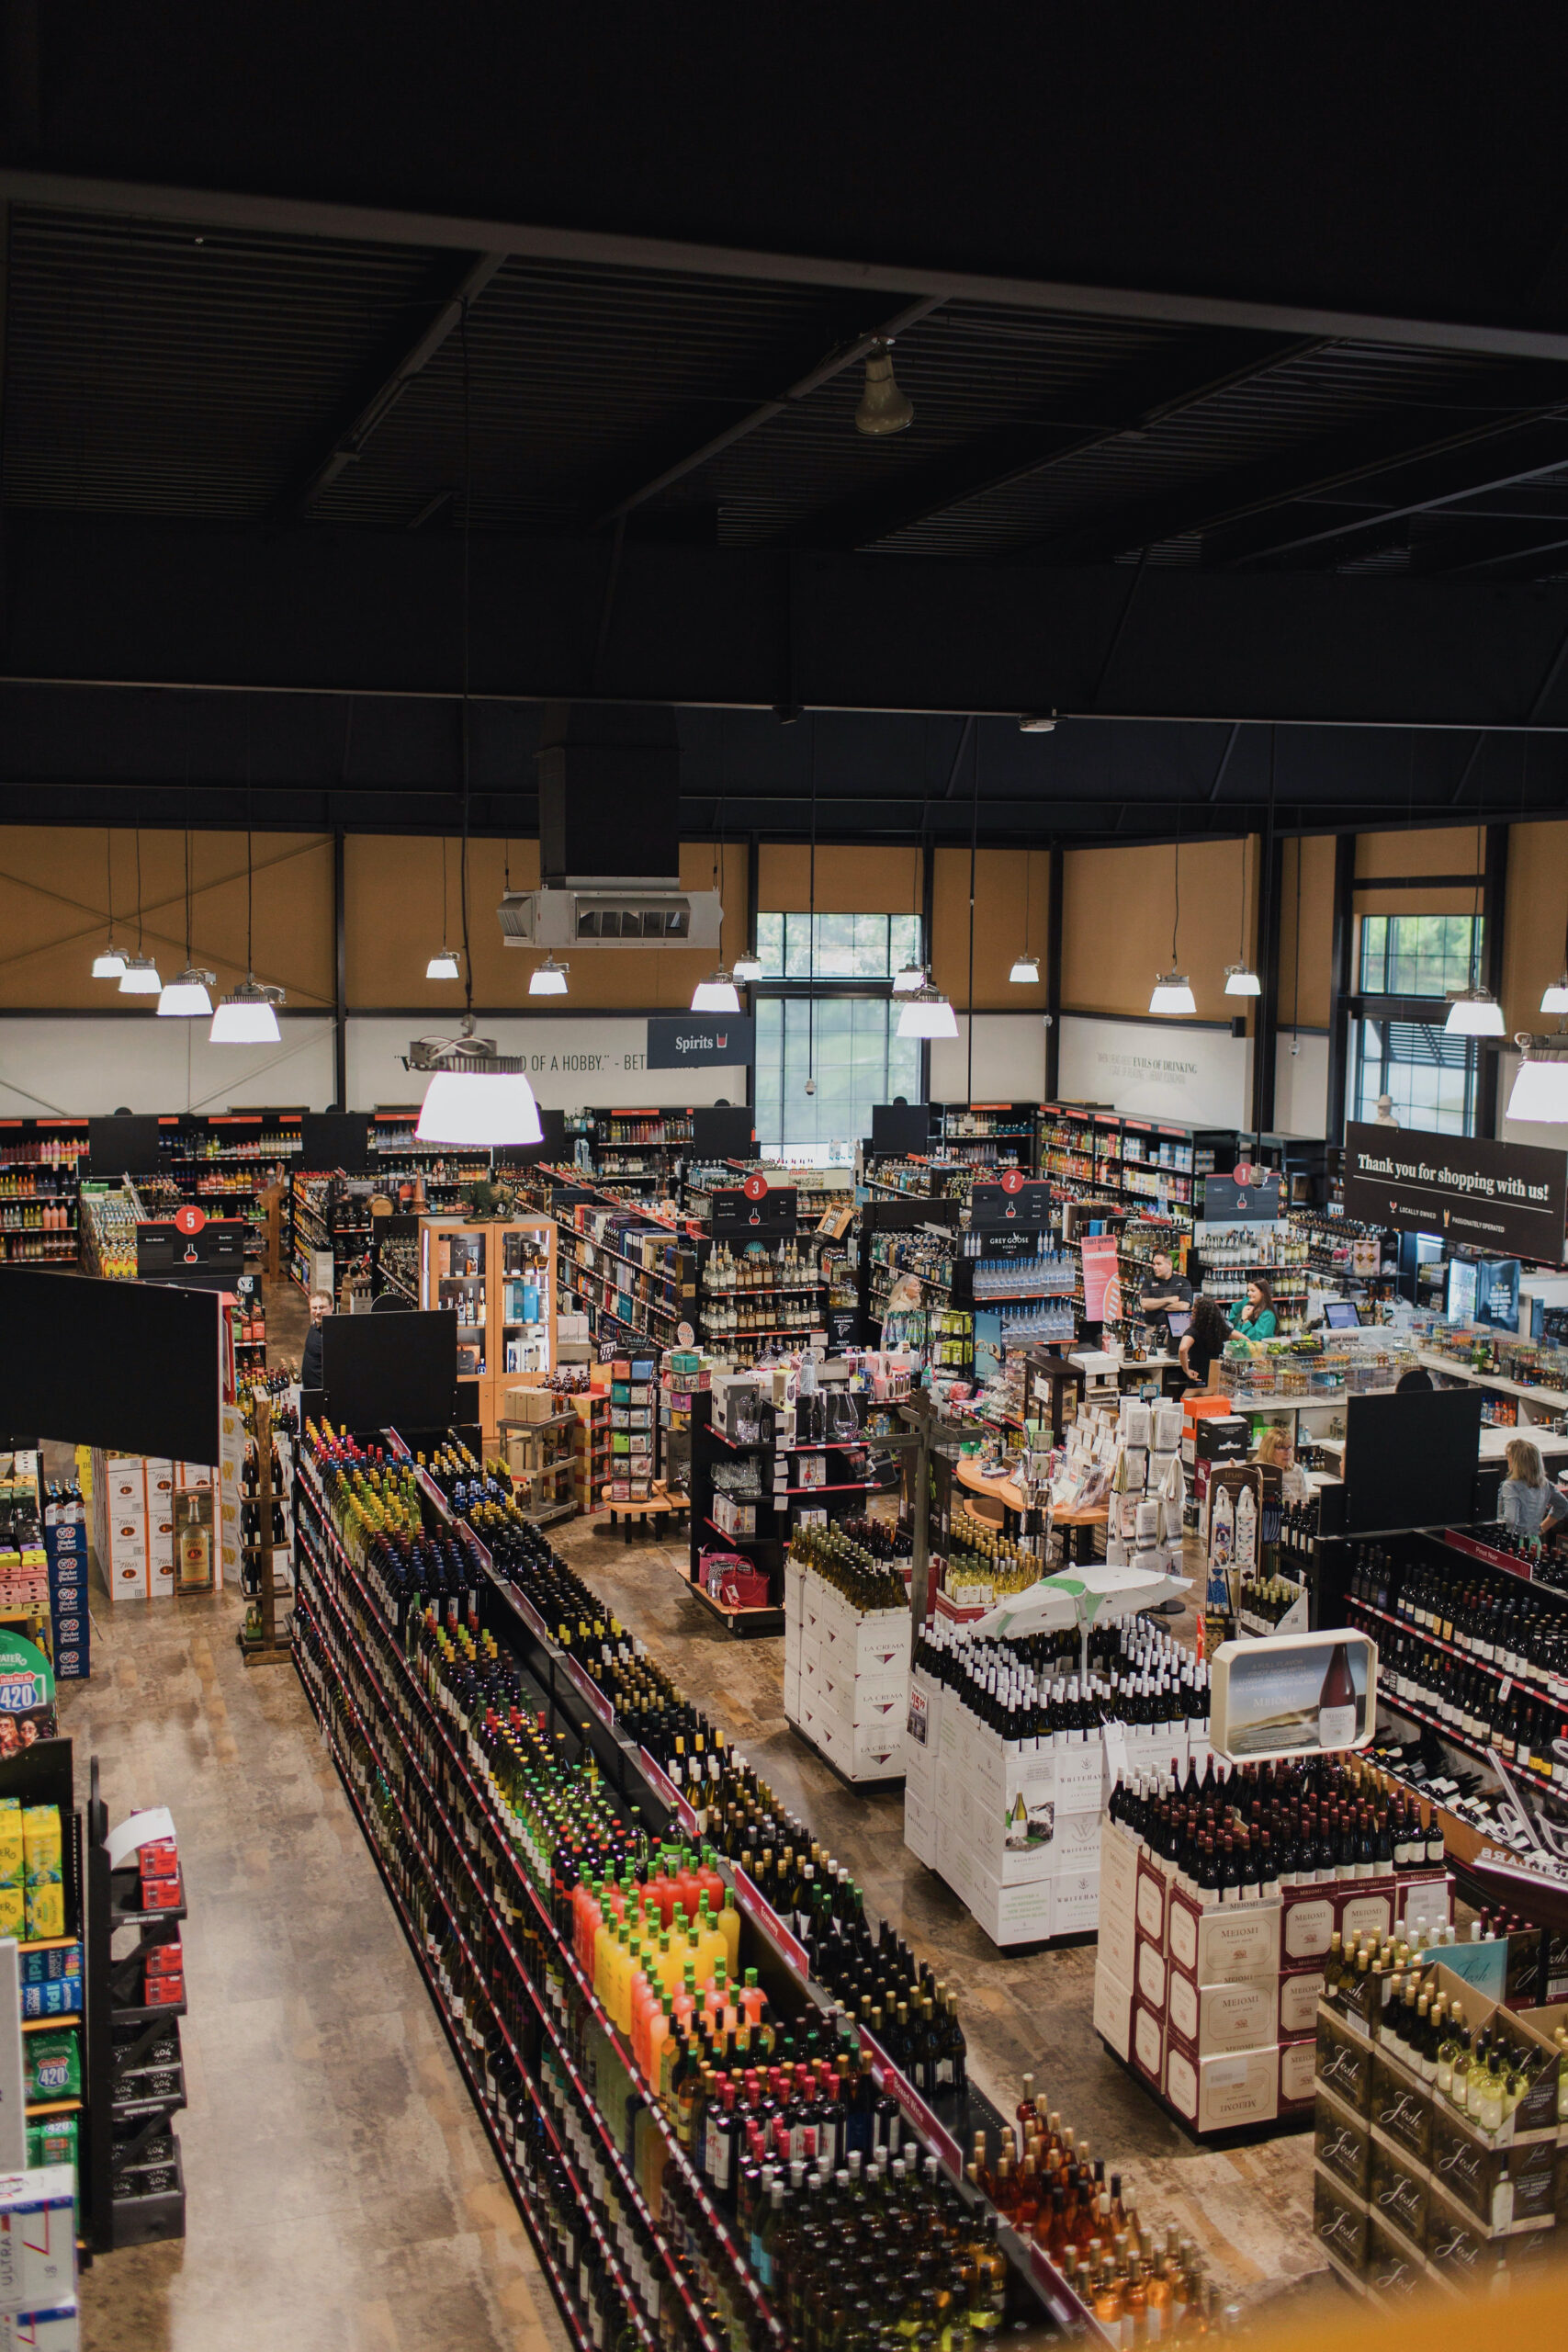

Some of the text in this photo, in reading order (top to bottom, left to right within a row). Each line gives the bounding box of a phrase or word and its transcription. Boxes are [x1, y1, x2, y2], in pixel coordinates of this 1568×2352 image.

[675, 1035, 714, 1053] Spirits
[531, 1056, 547, 1071] OF
[550, 1056, 559, 1071] A
[1133, 1057, 1152, 1069] EVILS
[1152, 1058, 1162, 1070] OF
[1163, 1059, 1198, 1074] DRINKING
[1009, 1175, 1016, 1189] 2
[1242, 1168, 1247, 1182] 1
[1358, 1153, 1550, 1202] Thank you for shopping with us!
[752, 1181, 760, 1194] 3
[186, 1212, 195, 1227] 5
[1399, 1206, 1437, 1220] LOCALLY OWNED
[1451, 1216, 1506, 1233] PASSIONATELY OPERATED
[1475, 1545, 1498, 1562] Pinot Noir
[875, 1643, 905, 1651] CREMA
[0, 1685, 33, 1709] 420
[874, 1692, 904, 1702] CREMA
[1253, 1694, 1296, 1707] MEIOMI
[872, 1743, 901, 1751] CREMA
[1229, 1901, 1259, 1911] MEIOMI
[1351, 1907, 1382, 1918] MEIOMI
[1294, 1911, 1326, 1922] MEIOMI
[1221, 1927, 1259, 1939] MEIOMI
[28, 1951, 42, 1981] IPA
[1224, 1974, 1254, 1984] MEIOMI
[32, 1986, 40, 2015] VARIETY
[47, 1984, 61, 2013] IPA
[1222, 1995, 1259, 2008] MEIOMI
[153, 2049, 172, 2058] 404
[1224, 2042, 1255, 2053] MEIOMI
[1323, 2045, 1359, 2080] Josh
[40, 2067, 65, 2086] 420
[153, 2079, 171, 2088] 404
[115, 2086, 132, 2094] 404
[894, 2075, 924, 2123] Boxed Wine
[1220, 2098, 1257, 2113] MEIOMI
[1380, 2091, 1424, 2129] Josh
[47, 2120, 71, 2132] 420
[147, 2146, 164, 2155] 404
[1323, 2126, 1359, 2163] Josh
[1438, 2138, 1481, 2178] Josh
[150, 2177, 167, 2186] 404
[1379, 2174, 1421, 2213] Josh
[1321, 2206, 1359, 2244] Josh
[1434, 2226, 1479, 2264] Josh
[1, 2235, 13, 2287] ULTRA
[1377, 2258, 1416, 2294] Josh
